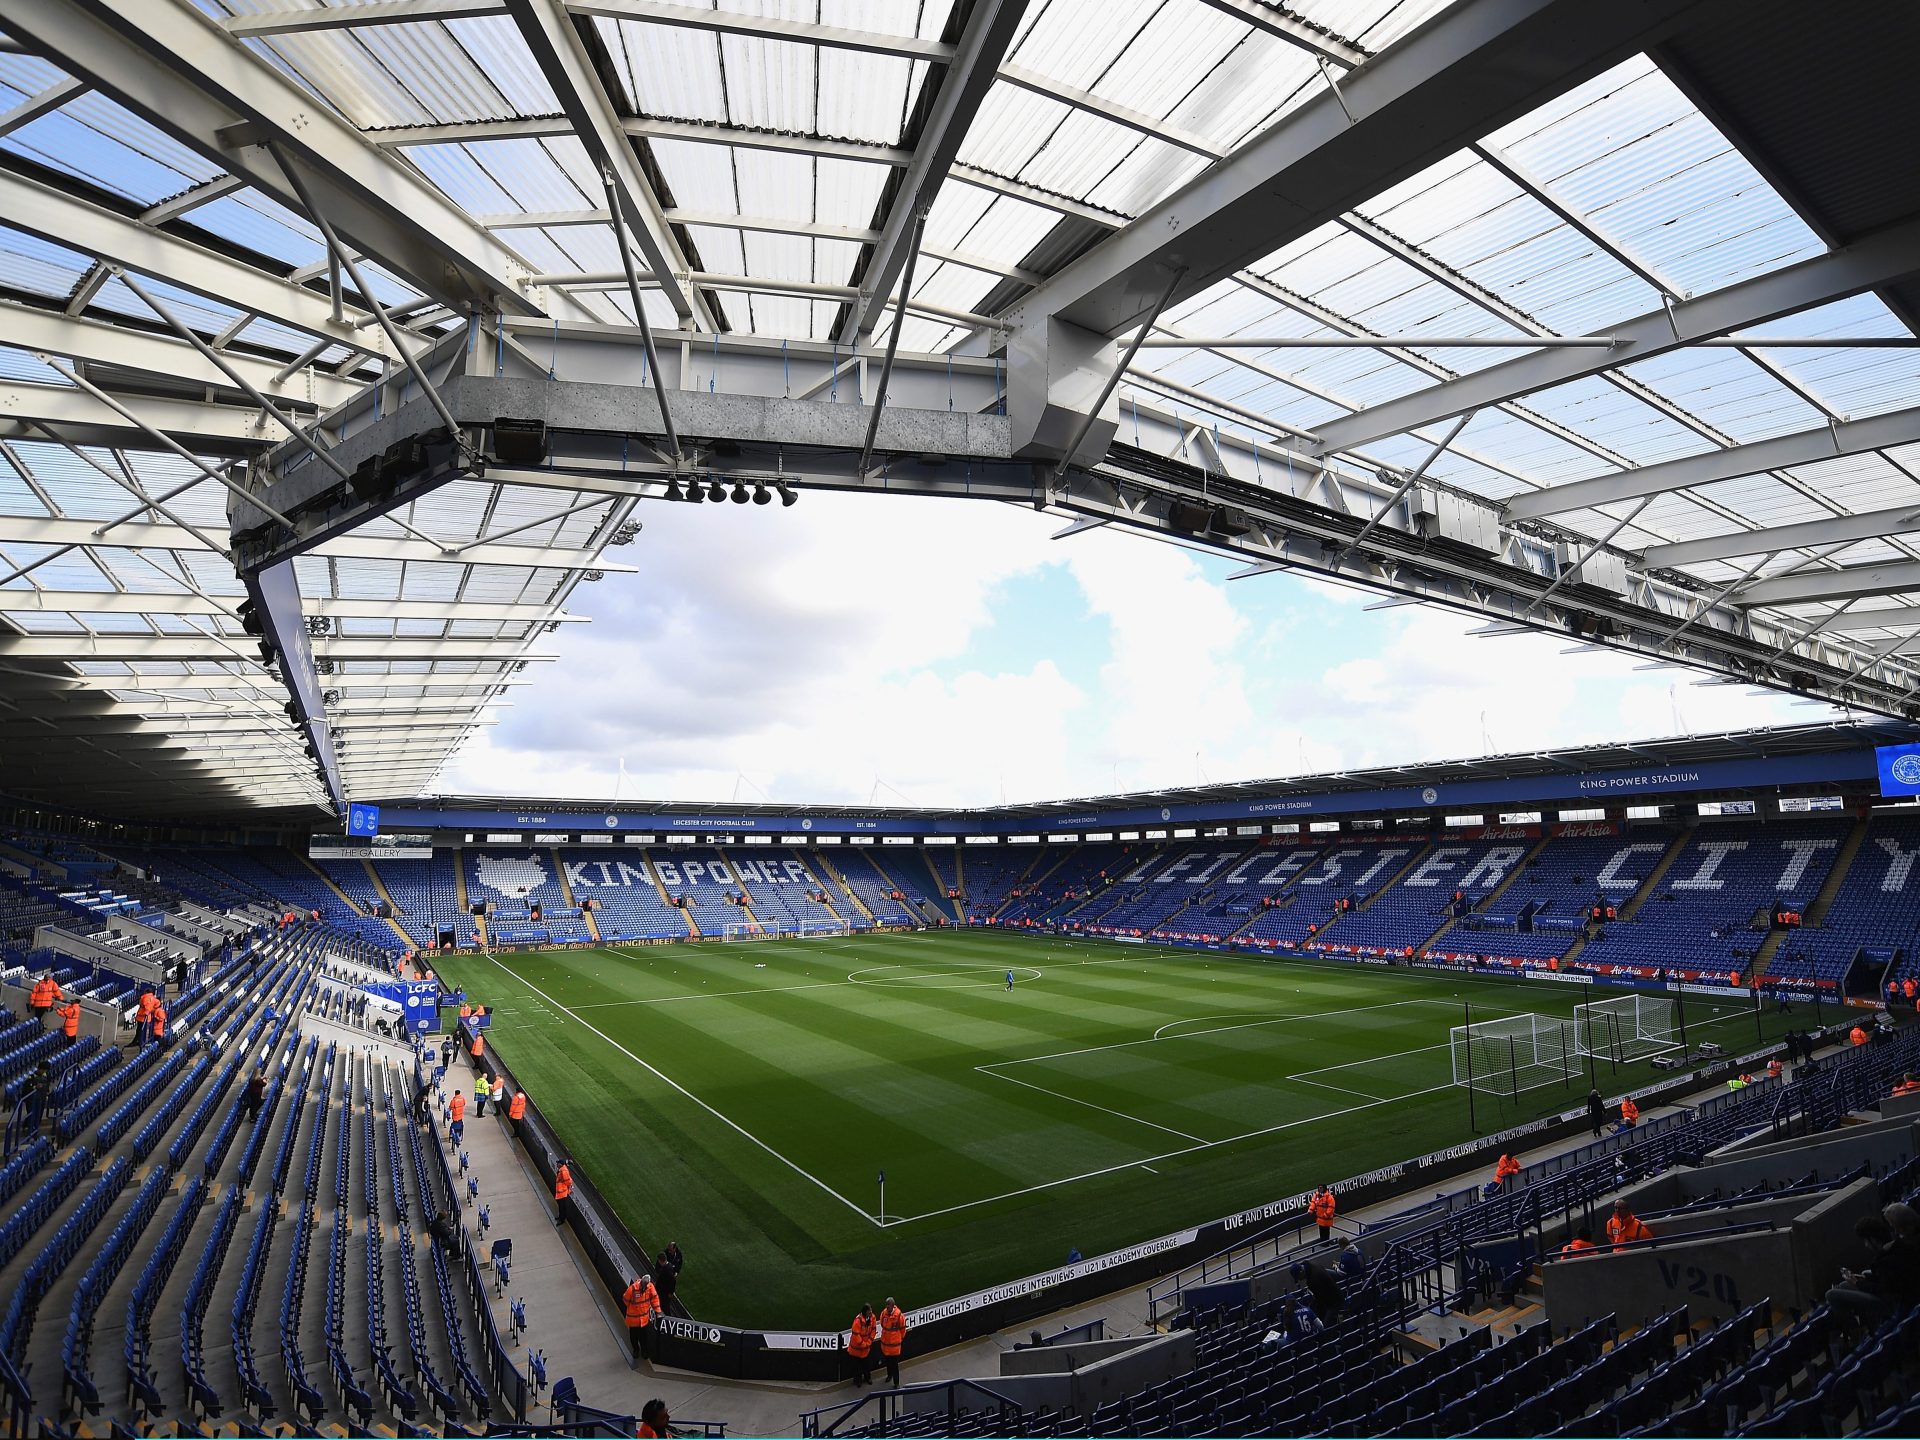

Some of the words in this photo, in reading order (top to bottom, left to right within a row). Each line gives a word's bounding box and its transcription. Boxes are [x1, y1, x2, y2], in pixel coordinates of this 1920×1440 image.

[1580, 780, 1607, 789] KING
[1610, 776, 1648, 787] POWER
[1651, 773, 1699, 784] STADIUM
[1249, 804, 1264, 812] KING
[340, 849, 357, 857] THE
[360, 849, 400, 857] GALLERY
[1123, 847, 1524, 888] LEICESTER
[1596, 838, 1920, 891] CITY
[152, 938, 168, 946] V10
[615, 939, 651, 948] SINGHA
[652, 938, 676, 946] BEER
[420, 950, 440, 958] BEER
[408, 984, 436, 993] LCFC
[1418, 1154, 1434, 1168] LIVE
[1434, 1152, 1446, 1164] AND
[1446, 1142, 1478, 1159] EXCLUSIVE
[1478, 1136, 1498, 1150] ONLINE
[1498, 1130, 1516, 1144] MATCH
[1516, 1120, 1548, 1138] COMMENTARY
[1224, 1214, 1244, 1231] LIVE
[1245, 1210, 1263, 1224] AND
[1264, 1196, 1307, 1218] EXCLUSIVE
[1334, 1180, 1359, 1196] MATCH
[918, 1300, 972, 1325] HIGHLIGHTS
[982, 1282, 1026, 1305] EXCLUSIVE
[1028, 1268, 1076, 1291] INTERVIEWS
[1084, 1262, 1100, 1274] U21
[1101, 1259, 1108, 1269] &
[1108, 1248, 1142, 1267] ACADEMY
[1143, 1237, 1178, 1256] COVERAGE
